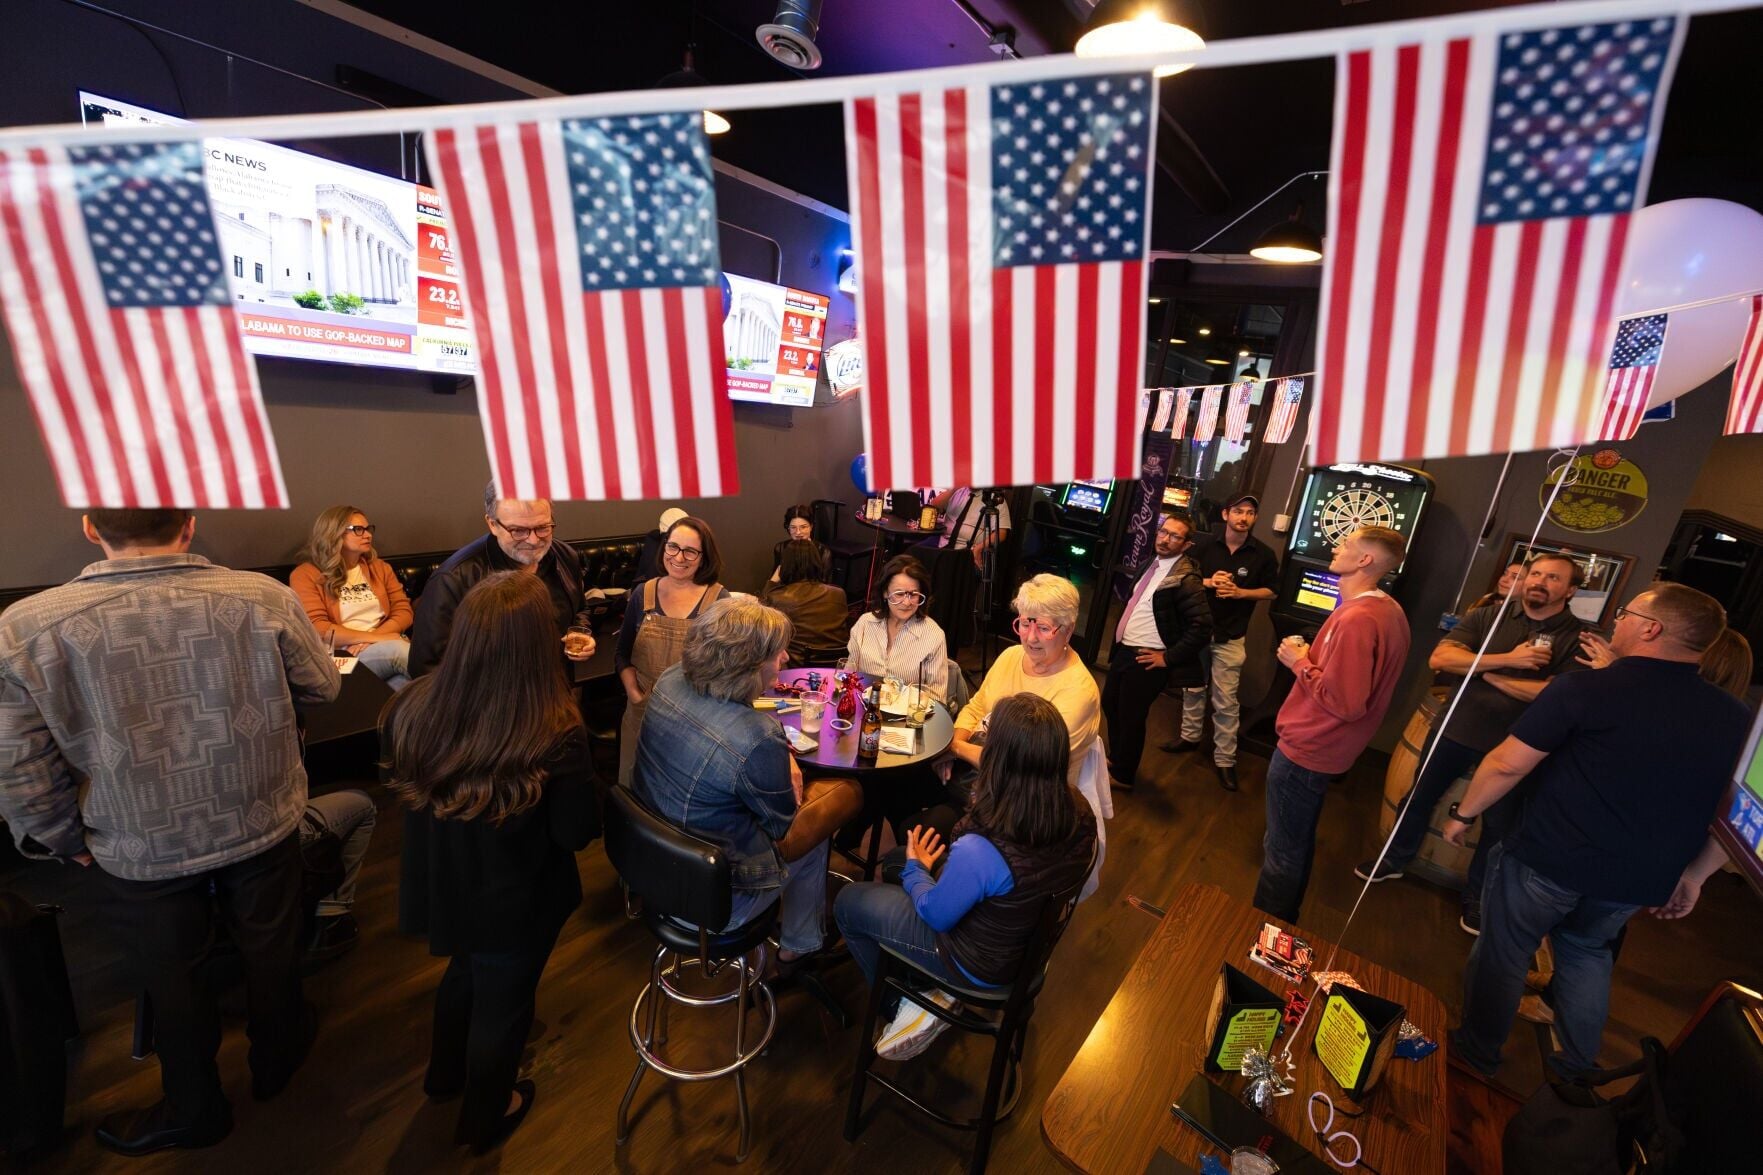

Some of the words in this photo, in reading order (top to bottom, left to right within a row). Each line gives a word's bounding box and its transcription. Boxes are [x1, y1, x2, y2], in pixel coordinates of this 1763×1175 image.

[224, 152, 267, 172] NEWS
[287, 324, 302, 337] TO
[303, 326, 324, 340] USE
[325, 328, 385, 346] GOP-BACKED
[386, 336, 407, 348] MAP
[1131, 479, 1155, 547] Royal
